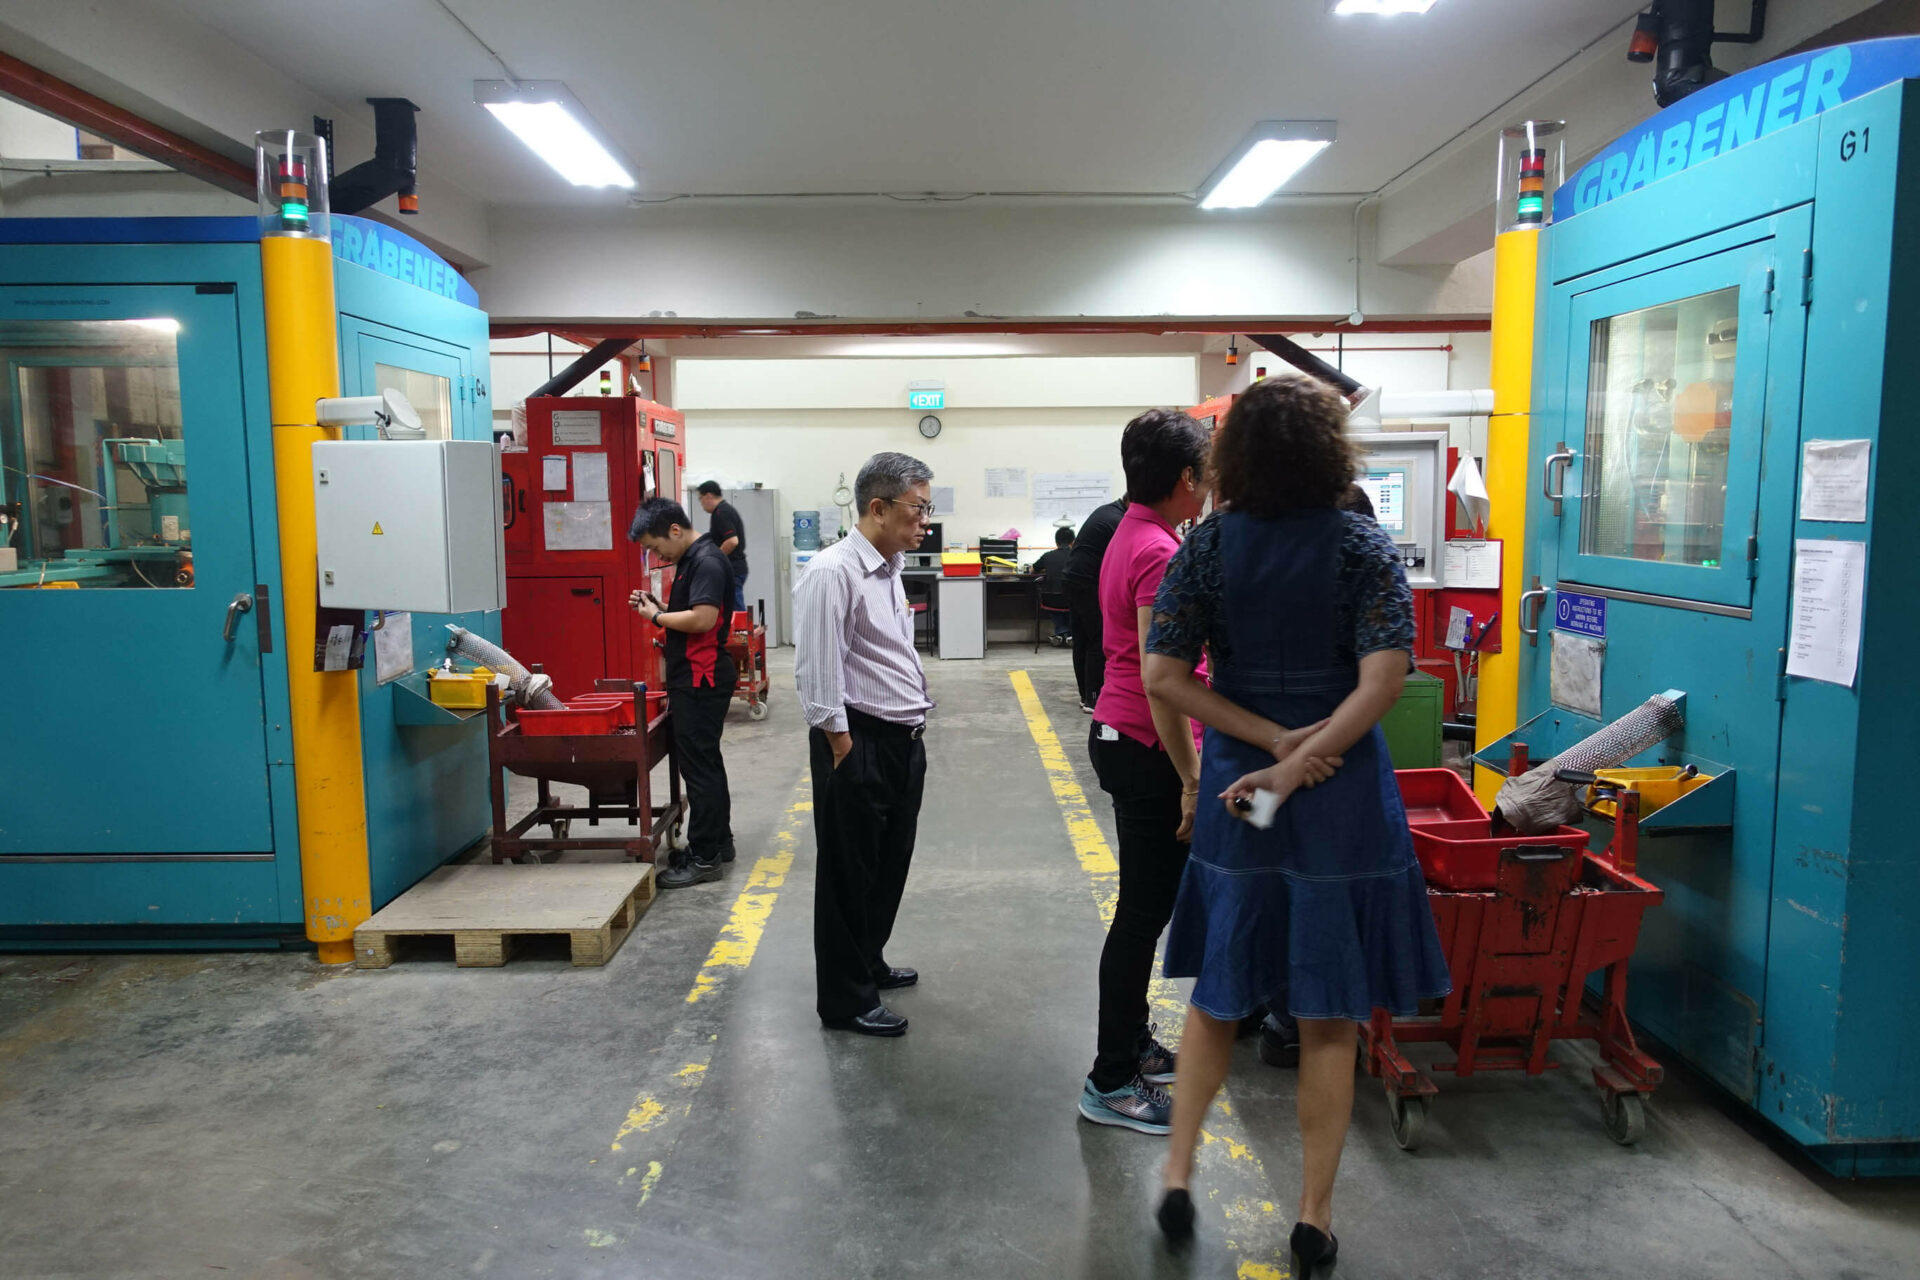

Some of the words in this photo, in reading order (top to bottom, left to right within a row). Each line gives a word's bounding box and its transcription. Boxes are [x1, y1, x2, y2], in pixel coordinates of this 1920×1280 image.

[1573, 46, 1852, 215] GRÄBENER
[1840, 126, 1870, 162] G1
[918, 394, 941, 406] EXIT
